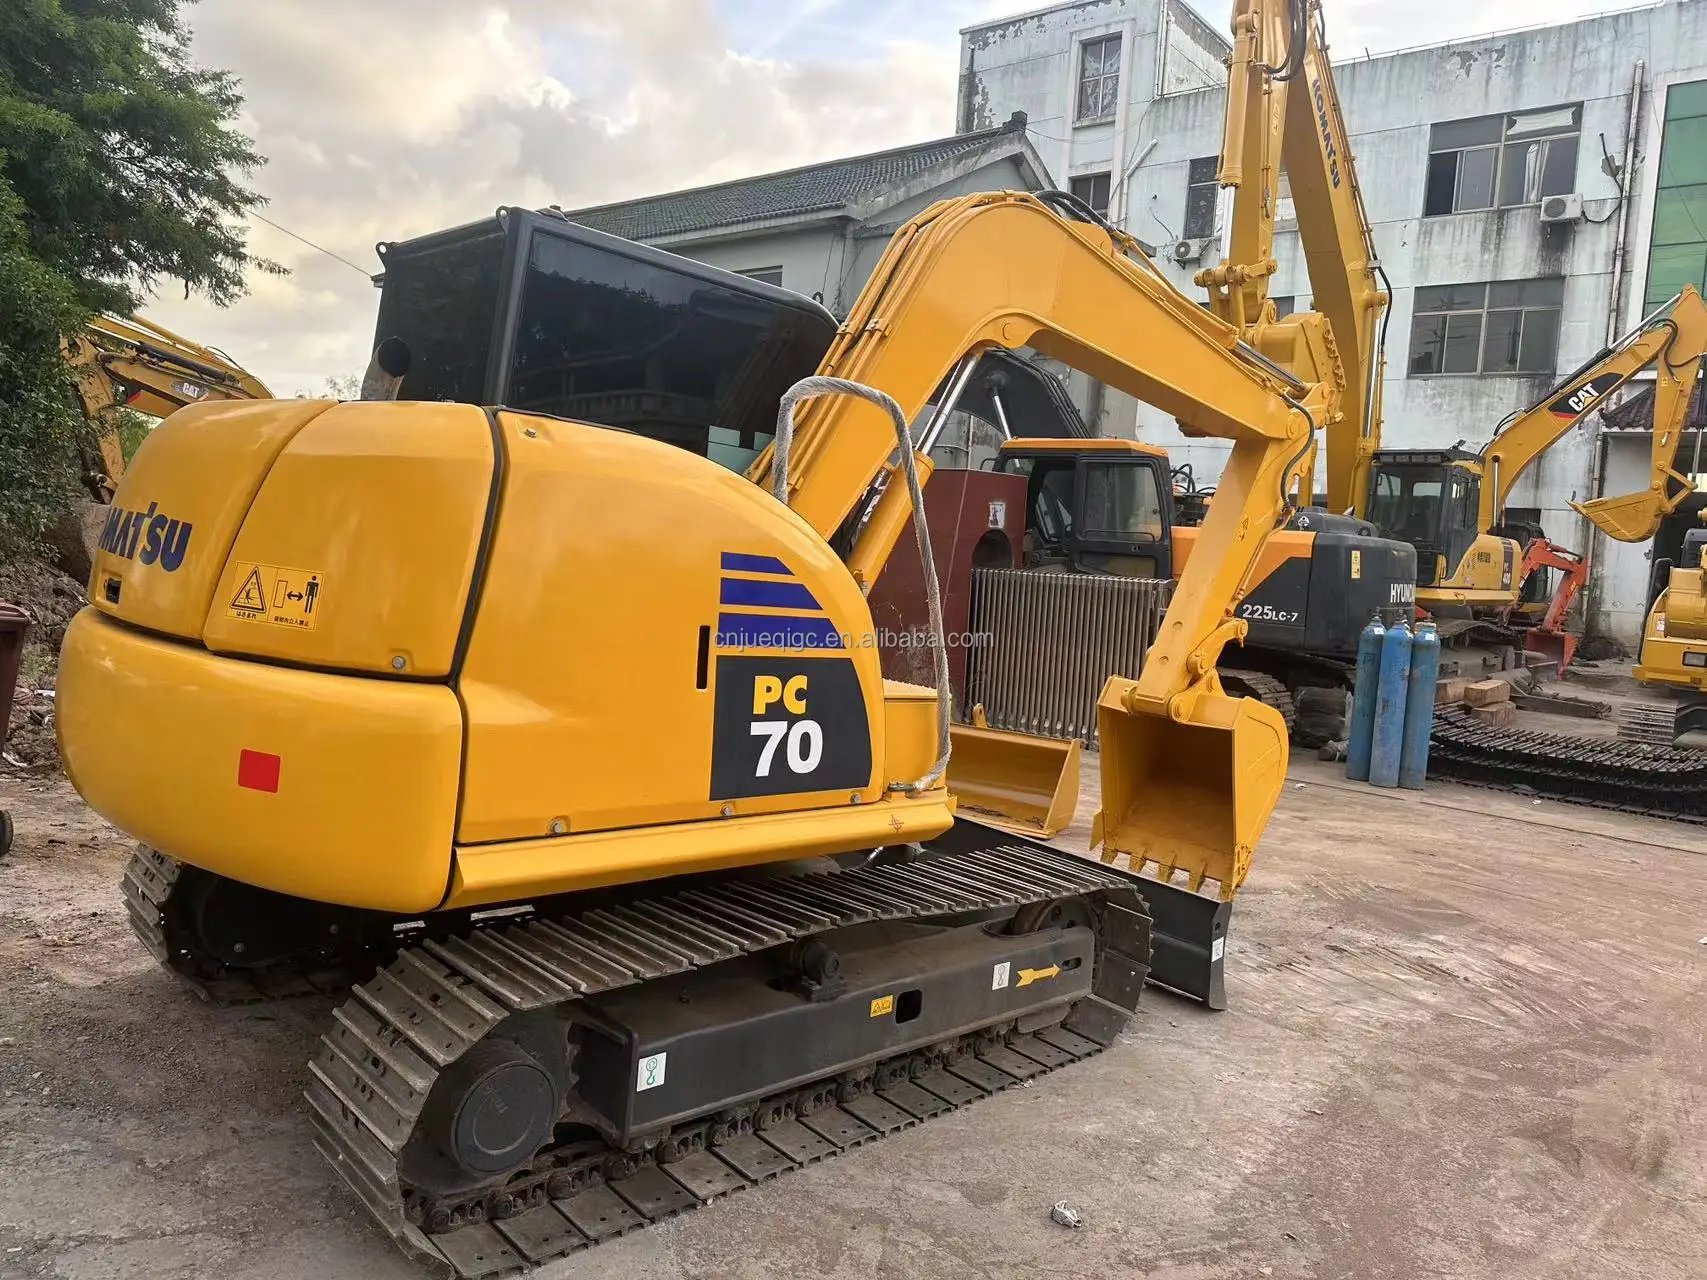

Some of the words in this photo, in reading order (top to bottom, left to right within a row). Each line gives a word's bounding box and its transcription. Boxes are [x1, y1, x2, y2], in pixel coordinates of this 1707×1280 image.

[1312, 79, 1340, 189] KOMATSU
[182, 382, 200, 398] CAT
[1568, 382, 1600, 412] CAT
[752, 675, 808, 715] PC
[749, 719, 824, 778] 70
